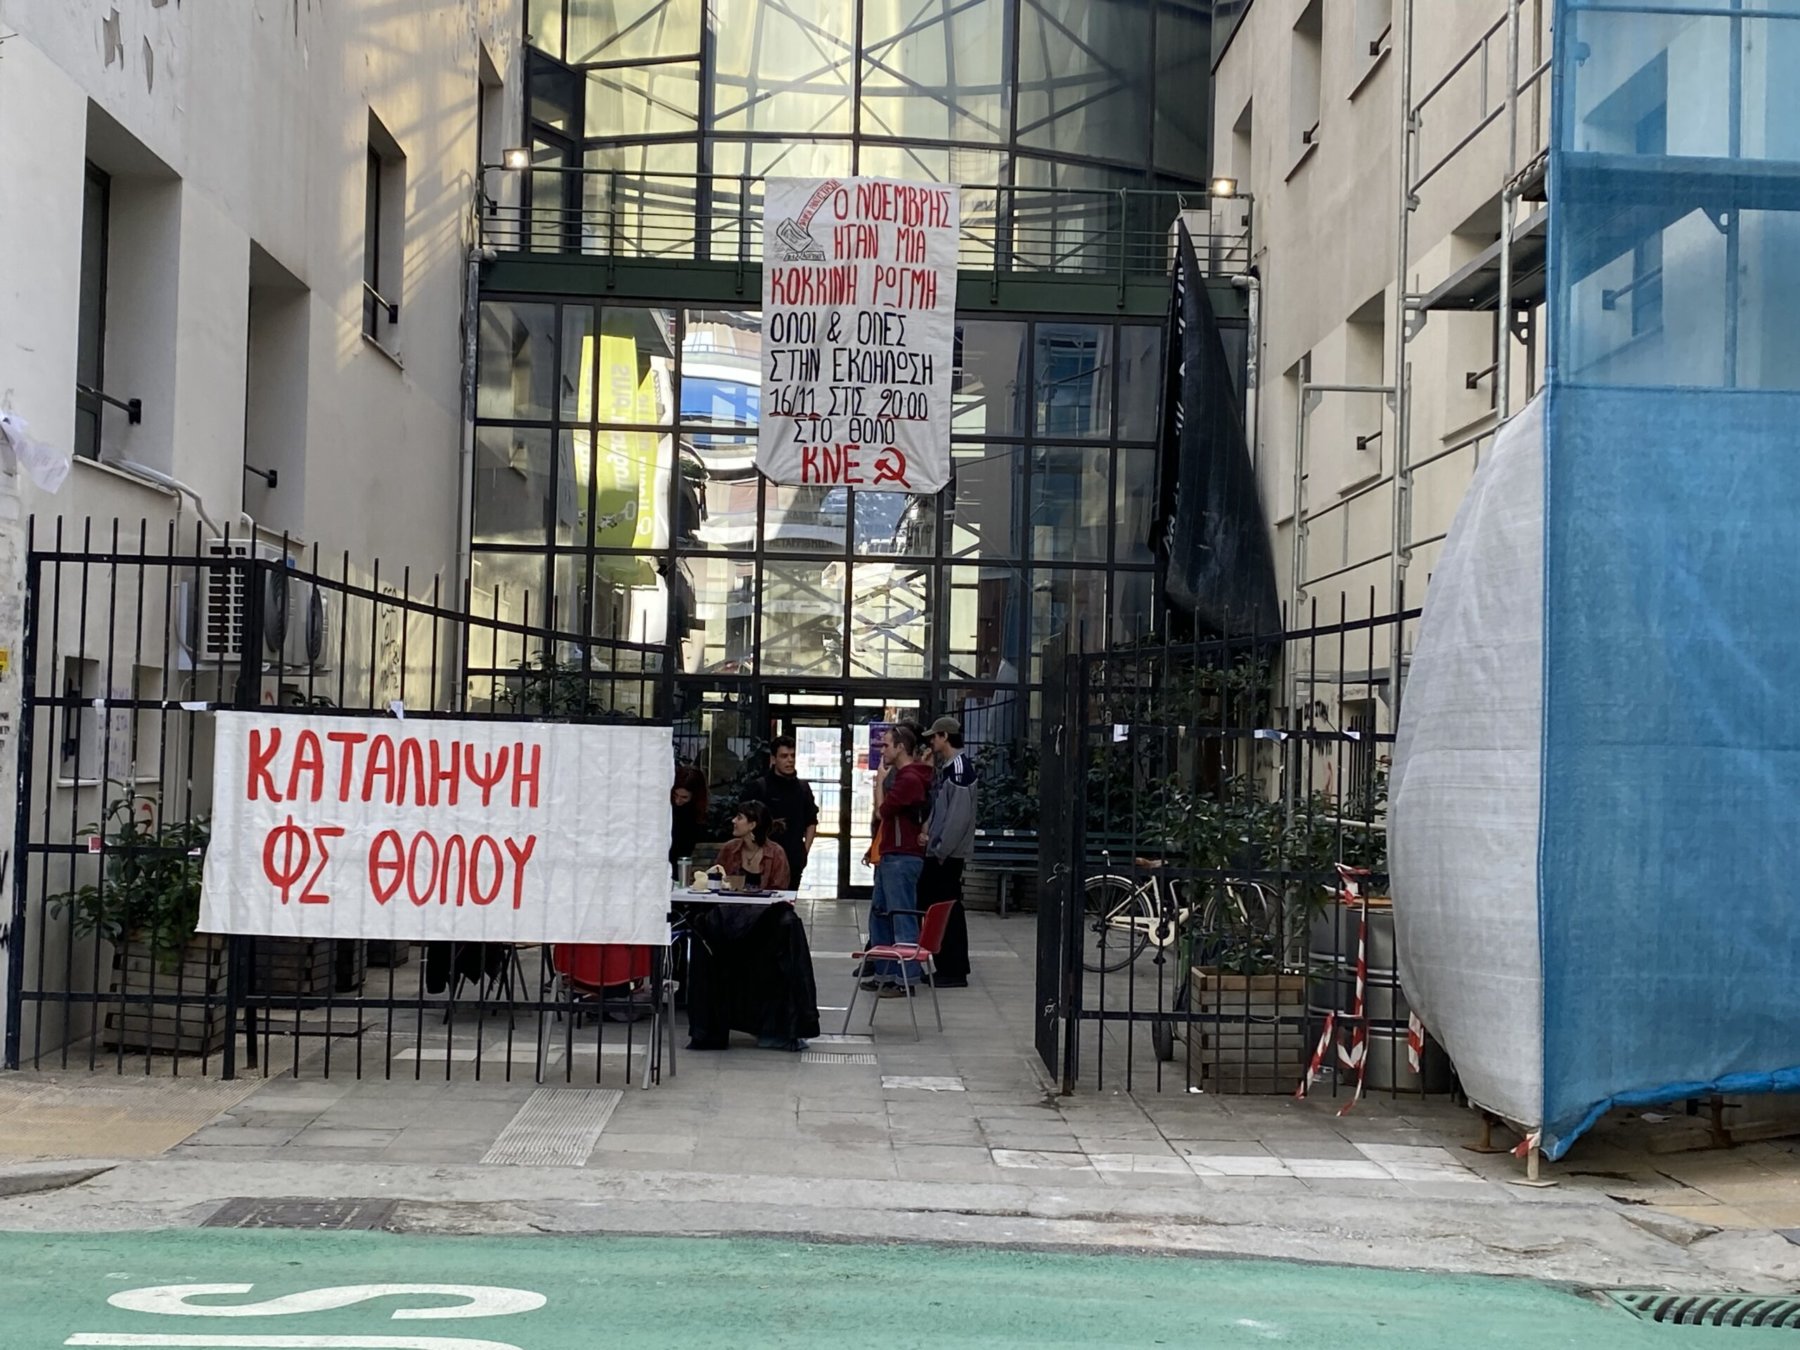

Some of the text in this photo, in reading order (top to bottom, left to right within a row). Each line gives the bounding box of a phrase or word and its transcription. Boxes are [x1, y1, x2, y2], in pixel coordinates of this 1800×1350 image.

[834, 188, 849, 221] Ο
[856, 182, 952, 228] ΝΟΕΜΒΡΗΣ
[833, 223, 926, 263] ΗΤΑΝ ΜΙΑ
[771, 265, 858, 306] ΚΟΚΚΙΝΗ
[770, 310, 907, 347] ΟΛΟΙ & ΟΛΕΣ
[769, 348, 821, 382] ΣΤΗΝ
[769, 385, 928, 420] 16/11 ΣΤΙΣ 20:00
[794, 417, 895, 445] ΣΤΟ ΘΟΛΟ
[802, 443, 864, 484] ΚΝΕ
[247, 727, 541, 807] ΚΑΤΑΛΗΨΗ
[263, 814, 537, 910] ΦΣ ΘΟΛΟΥ
